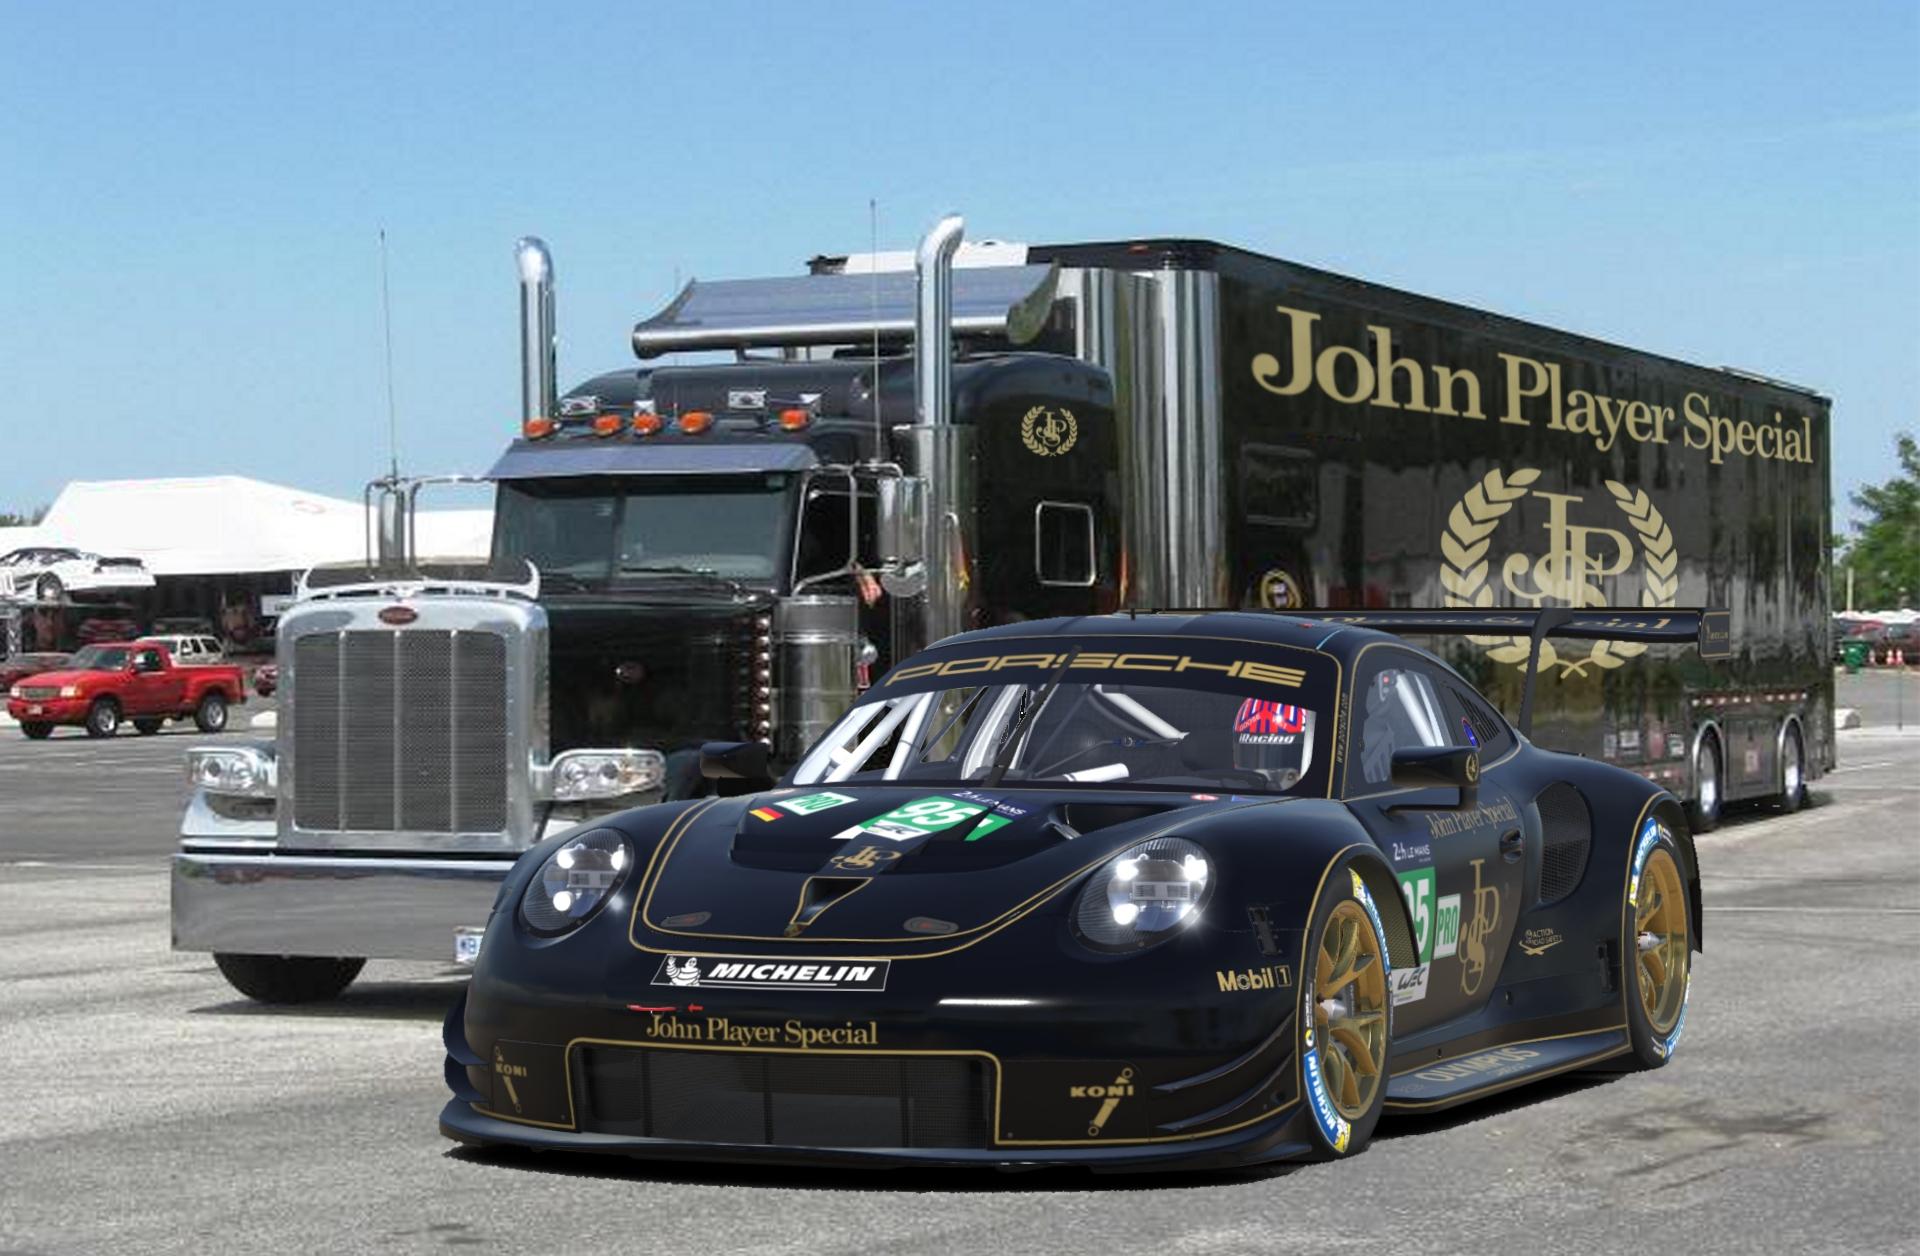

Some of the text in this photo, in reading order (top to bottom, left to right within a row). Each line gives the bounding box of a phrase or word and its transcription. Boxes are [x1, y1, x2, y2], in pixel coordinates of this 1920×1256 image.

[1252, 305, 1814, 464] John Player Special
[885, 653, 1307, 688] PORSCHE
[888, 800, 981, 826] 95
[1437, 905, 1459, 947] PRO
[708, 963, 876, 982] MICHELIN
[1216, 967, 1275, 992] Mobil
[647, 1014, 879, 1048] John Player Special
[496, 1063, 527, 1077] KONI
[1070, 1085, 1134, 1098] KONI
